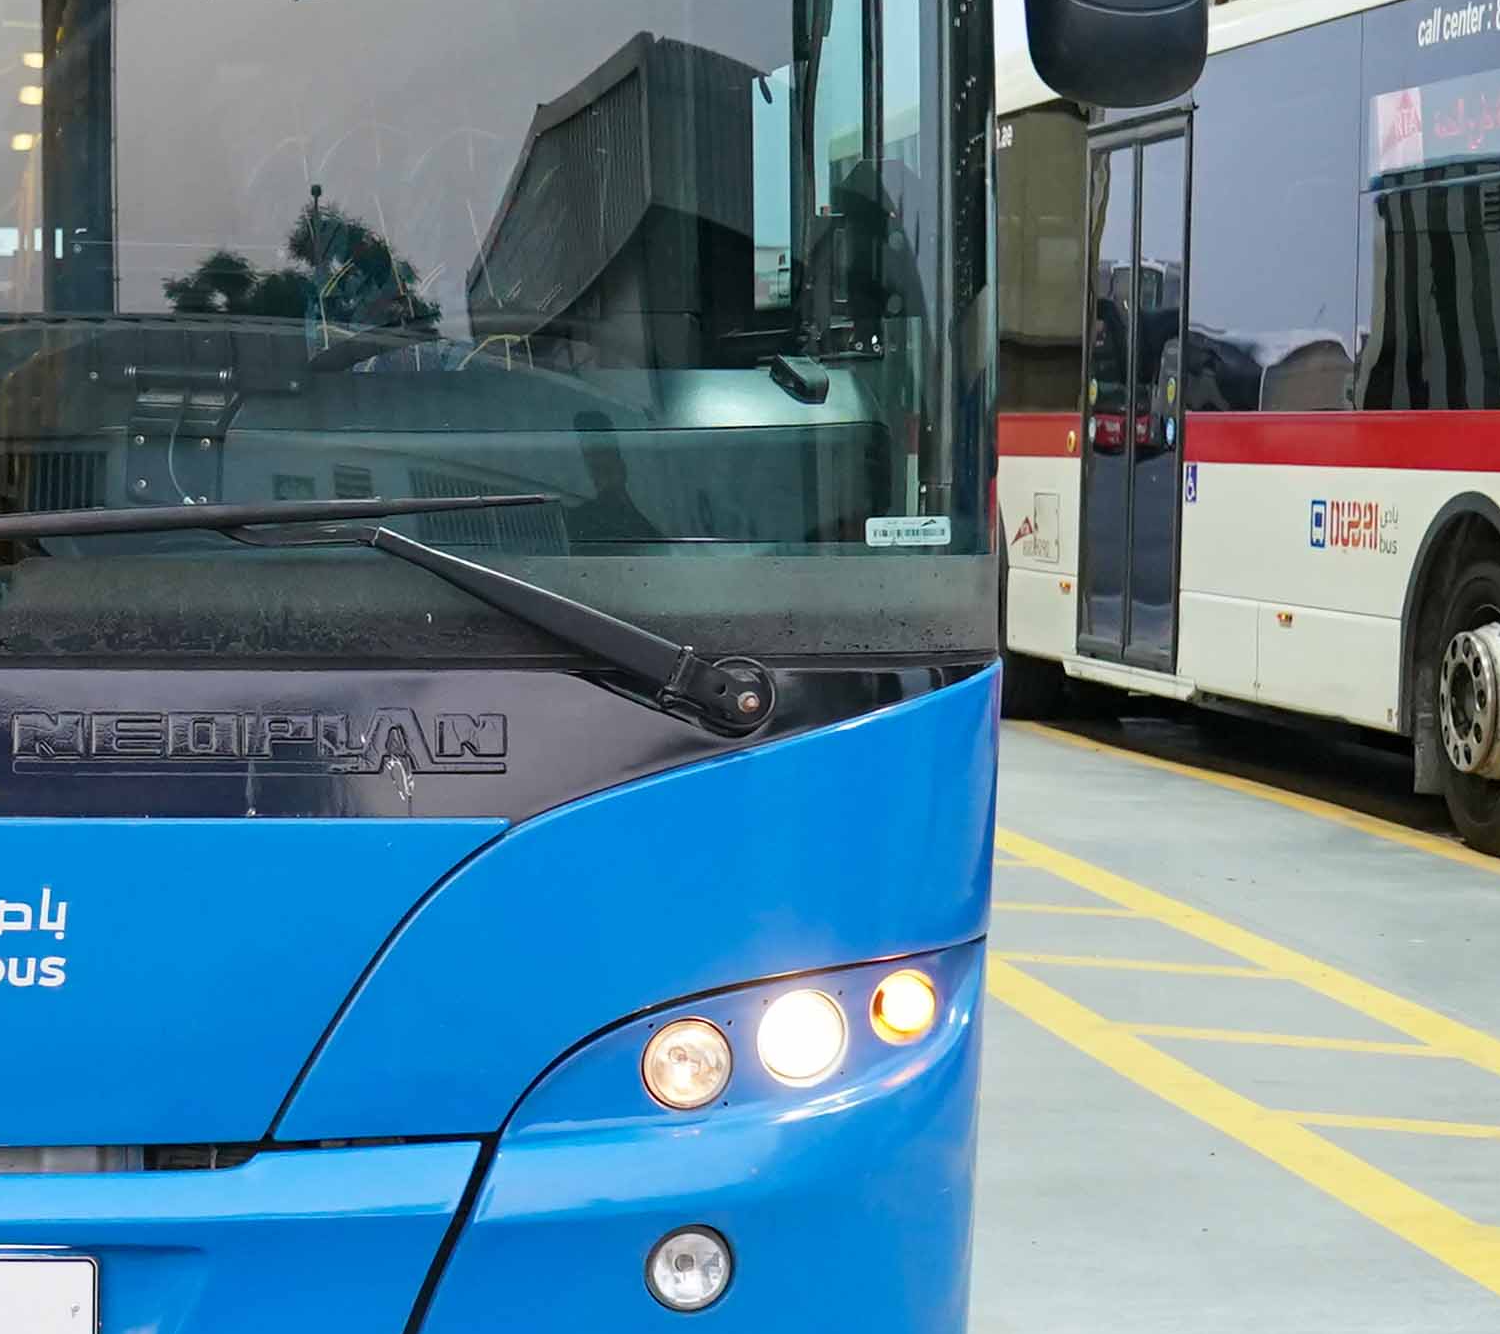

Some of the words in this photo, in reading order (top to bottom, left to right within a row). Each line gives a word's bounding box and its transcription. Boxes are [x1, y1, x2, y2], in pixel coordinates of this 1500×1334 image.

[1418, 7, 1442, 47] call
[1443, 2, 1485, 40] center
[1330, 501, 1378, 553] DUBAI
[11, 707, 508, 769] NEOPLAN
